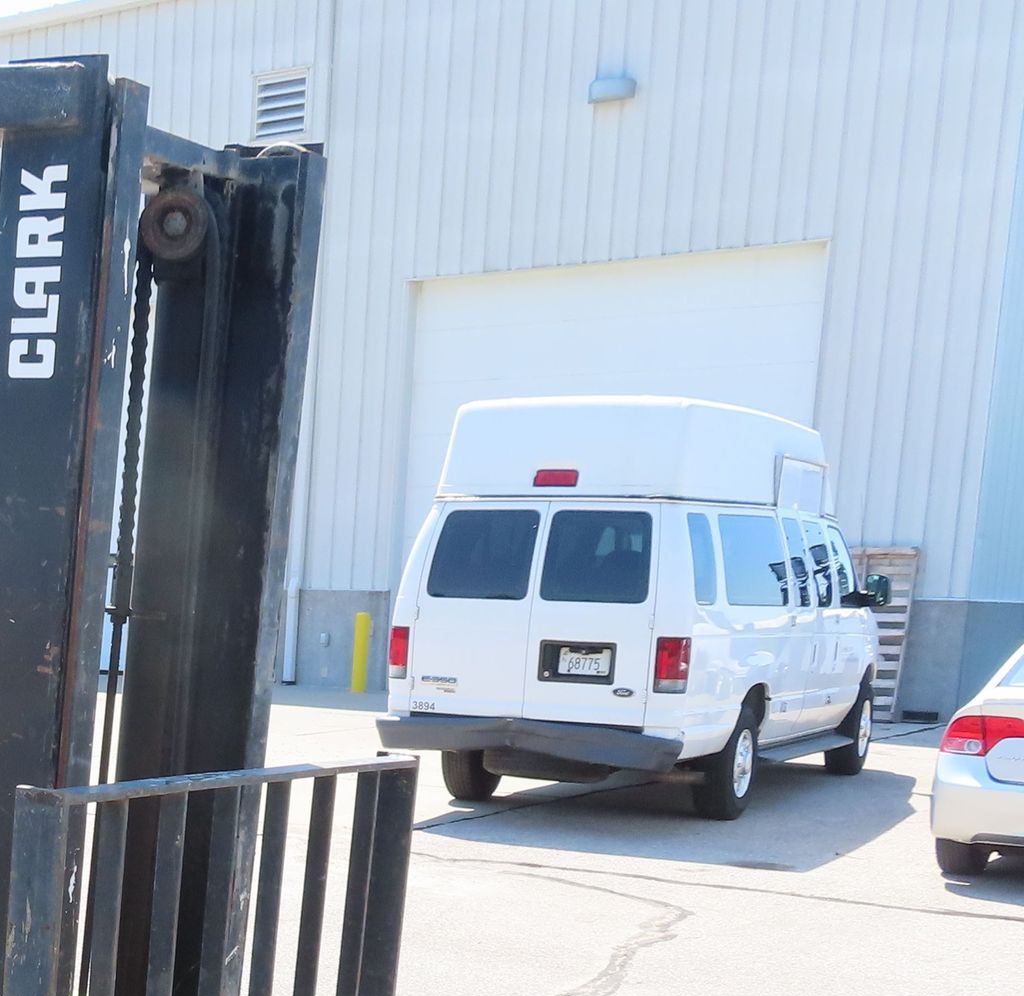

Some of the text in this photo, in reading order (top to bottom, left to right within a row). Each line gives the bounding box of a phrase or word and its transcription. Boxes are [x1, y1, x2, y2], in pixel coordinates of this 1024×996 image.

[8, 164, 69, 379] CLARK
[567, 656, 601, 671] 68775
[412, 701, 436, 710] 3894
